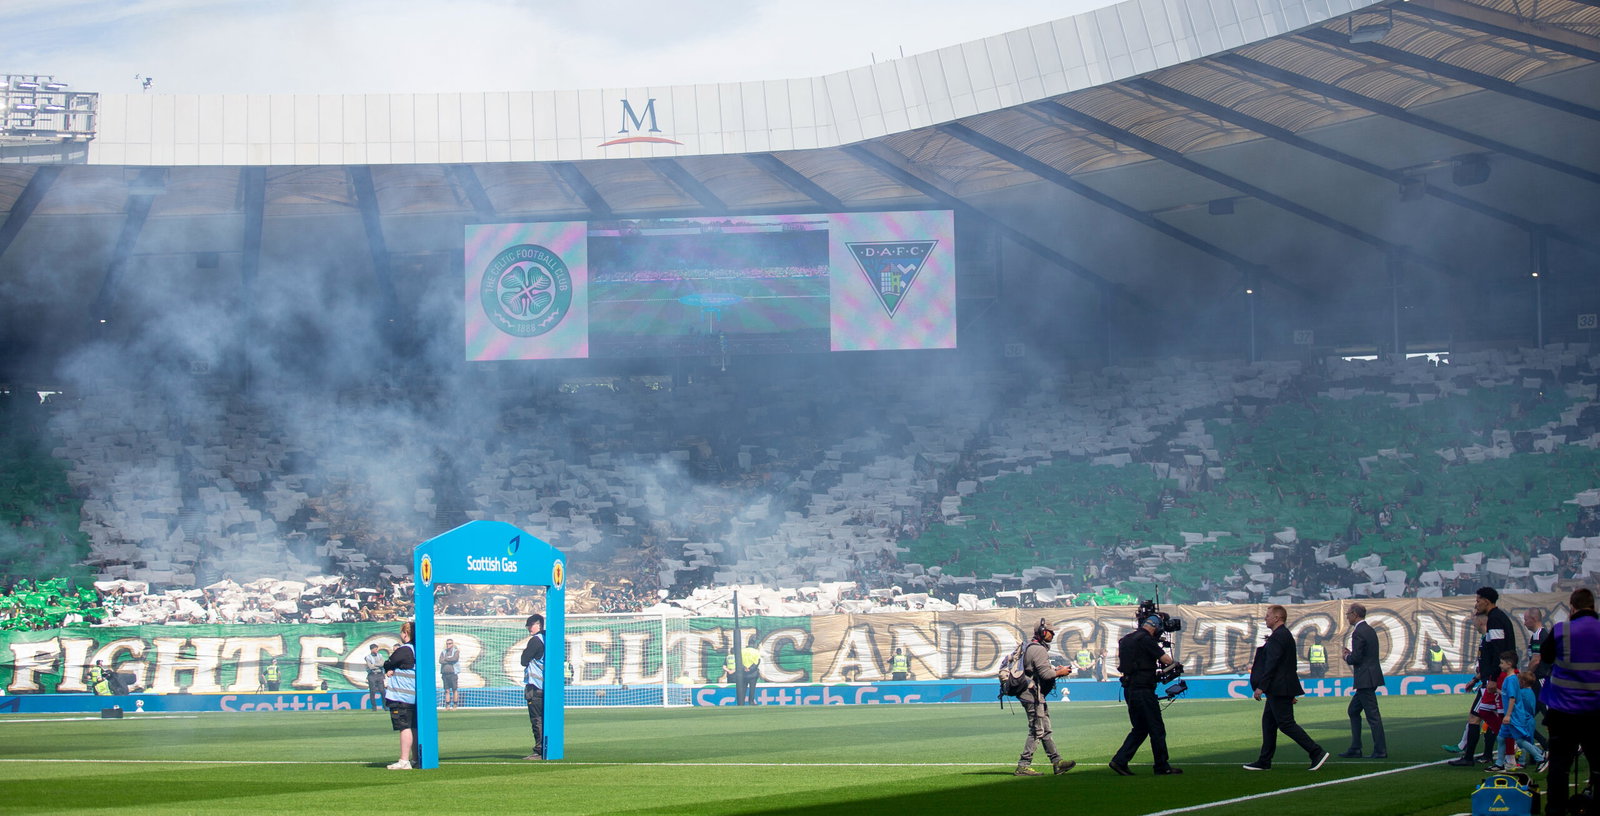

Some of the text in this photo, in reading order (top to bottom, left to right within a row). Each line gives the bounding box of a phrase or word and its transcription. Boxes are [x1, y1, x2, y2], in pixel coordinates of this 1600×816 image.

[617, 98, 662, 134] M
[485, 248, 568, 292] THE CELTIC FOOTBALL CLUB
[1579, 314, 1595, 327] 38
[467, 555, 518, 573] Scottish Gas
[8, 635, 287, 694] FIGHT
[821, 621, 1023, 684] AND
[697, 687, 842, 706] Scttish
